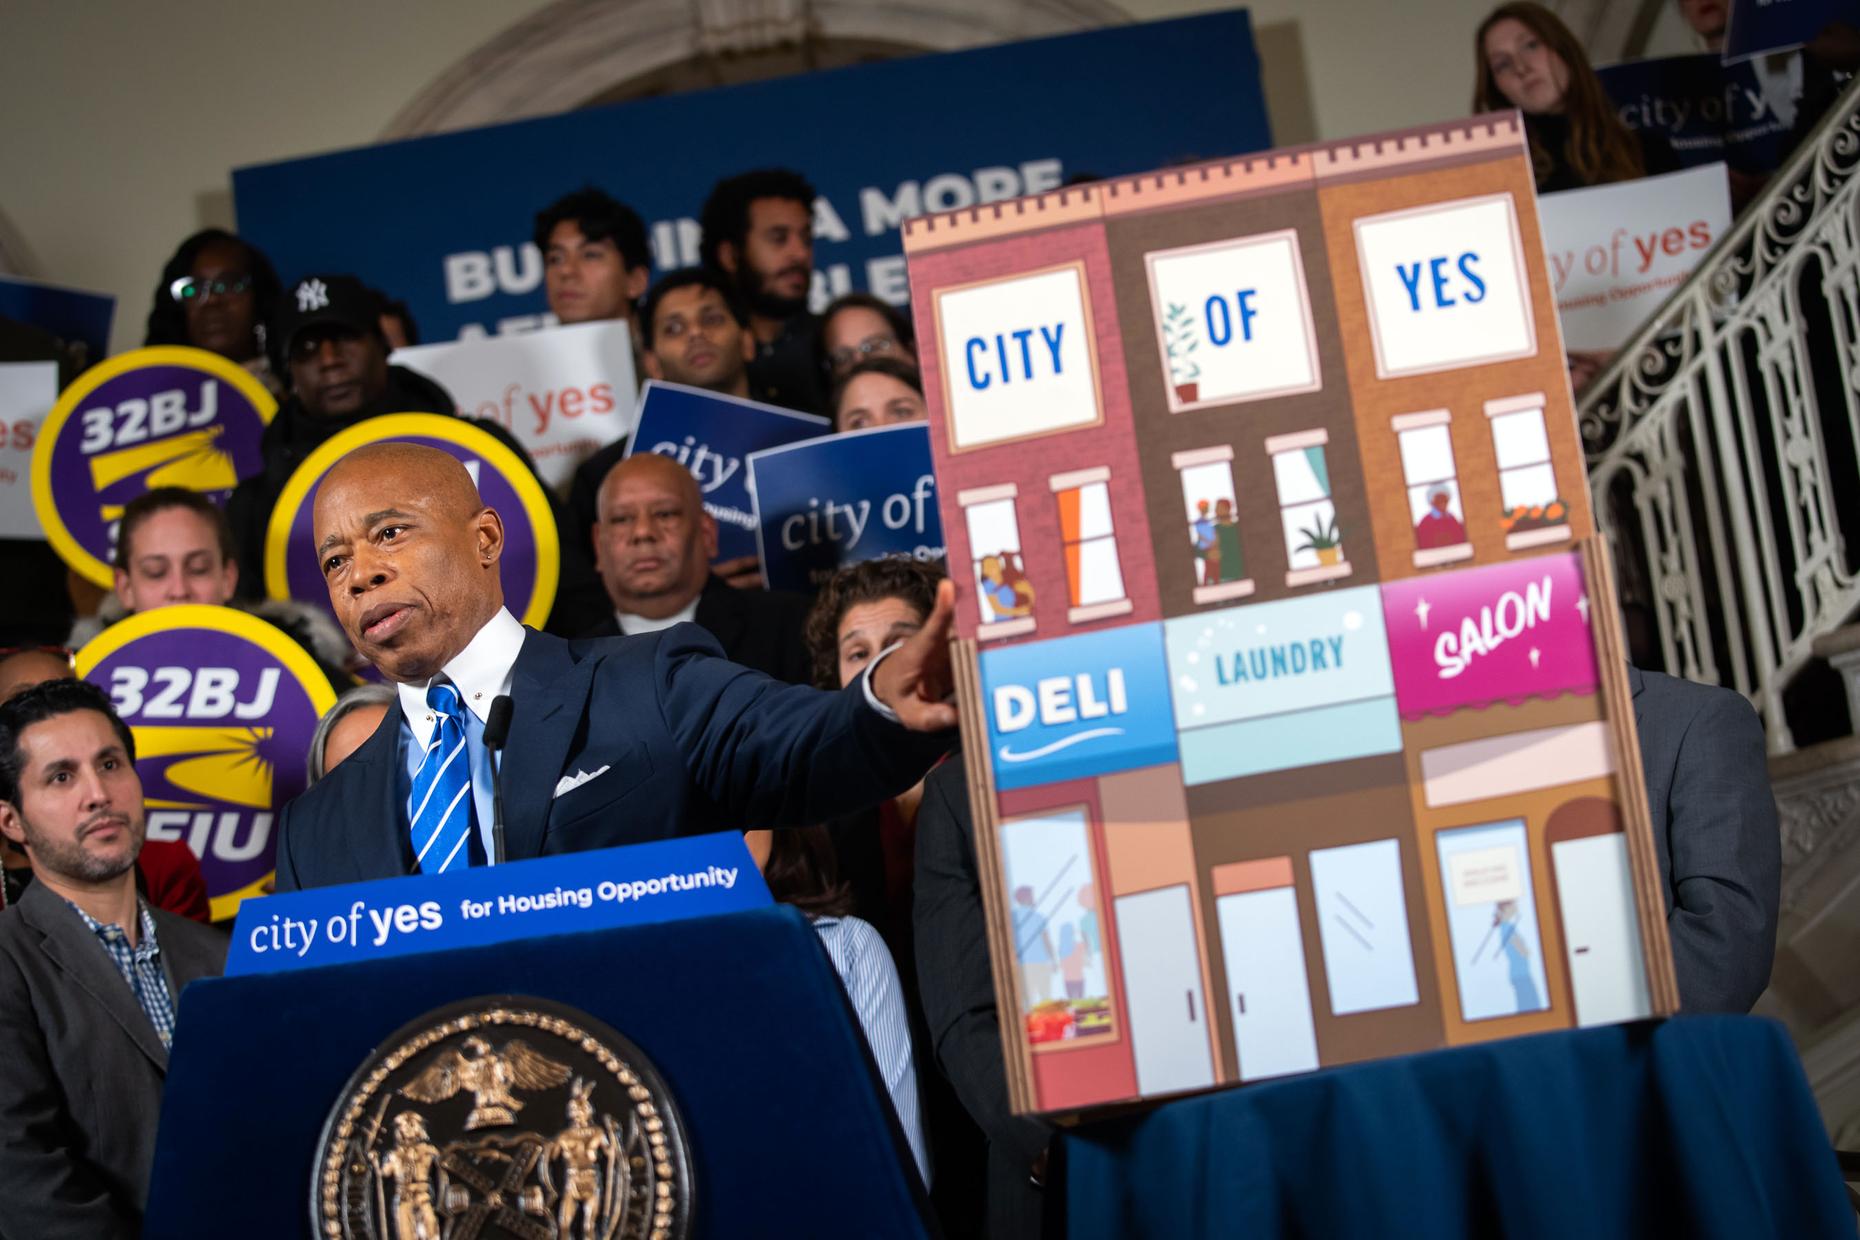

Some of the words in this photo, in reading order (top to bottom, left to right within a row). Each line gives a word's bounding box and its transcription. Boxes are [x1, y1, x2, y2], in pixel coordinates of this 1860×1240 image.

[859, 158, 1063, 236] MORE
[1584, 227, 1628, 278] of
[1633, 219, 1712, 274] yes
[966, 323, 1067, 391] CITY
[1205, 288, 1259, 347] OF
[1396, 251, 1487, 313] YES
[80, 379, 218, 454] 32BJ
[528, 383, 616, 436] yes
[781, 498, 871, 550] city
[882, 474, 935, 534] of
[1215, 635, 1344, 686] LAUNDRY
[1434, 575, 1552, 679] SALON
[110, 666, 281, 719] 32BJ
[994, 667, 1128, 733] DELI
[146, 811, 274, 862] EIU
[250, 914, 317, 957] city
[326, 901, 365, 947] of
[369, 901, 443, 947] yes
[460, 898, 493, 920] for
[498, 887, 593, 915] Housing
[597, 866, 738, 902] Opportunity
